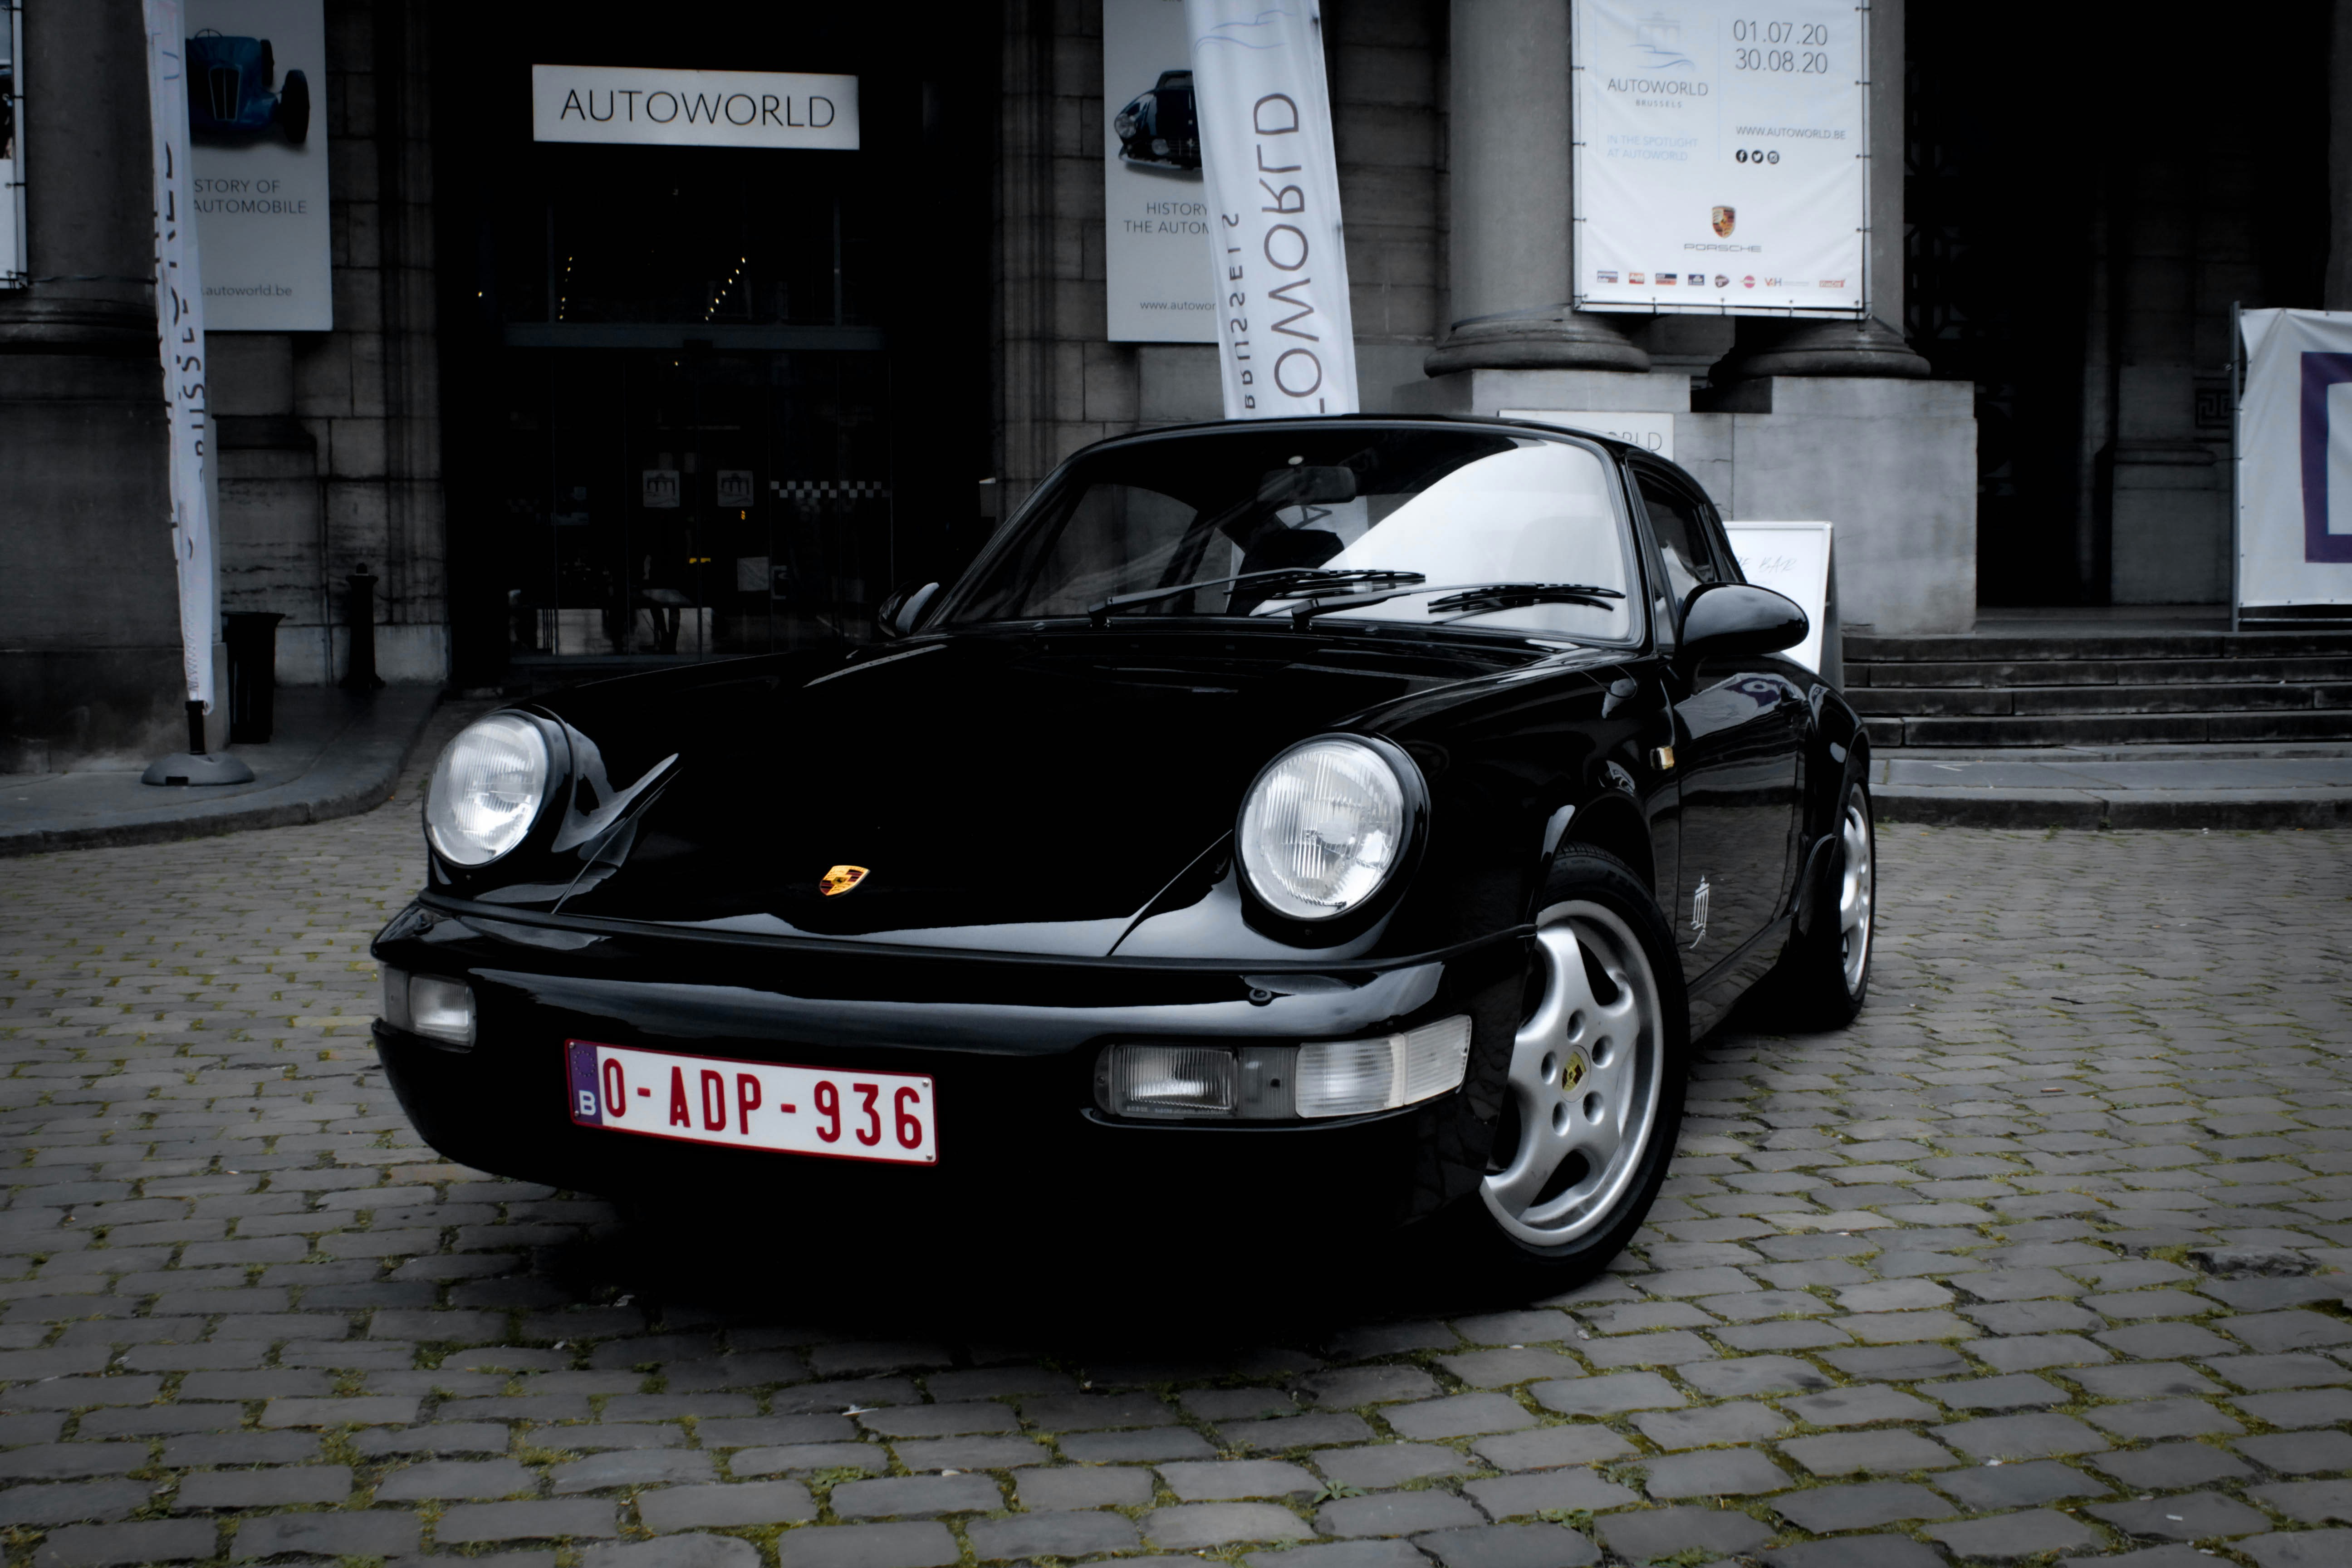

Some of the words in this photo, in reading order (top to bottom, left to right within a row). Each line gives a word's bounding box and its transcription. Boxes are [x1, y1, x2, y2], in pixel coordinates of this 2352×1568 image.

[1733, 19, 1828, 46] 01.07.20
[1735, 48, 1828, 74] 30.08.20
[1607, 78, 1709, 97] AUTOWORLD
[560, 89, 835, 128] AUTOWORLD
[1635, 98, 1682, 108] BRUSSELS
[1735, 125, 1847, 139] WWW.AUTOWORLD.BE
[1607, 134, 1618, 144] IN
[1621, 135, 1641, 146] THE
[1642, 135, 1699, 148] SPOTLIGHT
[1622, 149, 1688, 162] AUTOWORLD
[256, 179, 280, 194] OF
[194, 199, 308, 214] AUTOMOBILE
[1146, 202, 1207, 216] HISTORY
[1123, 220, 1153, 234] THE
[1683, 243, 1762, 253] PORSCHE
[578, 1089, 597, 1116] B
